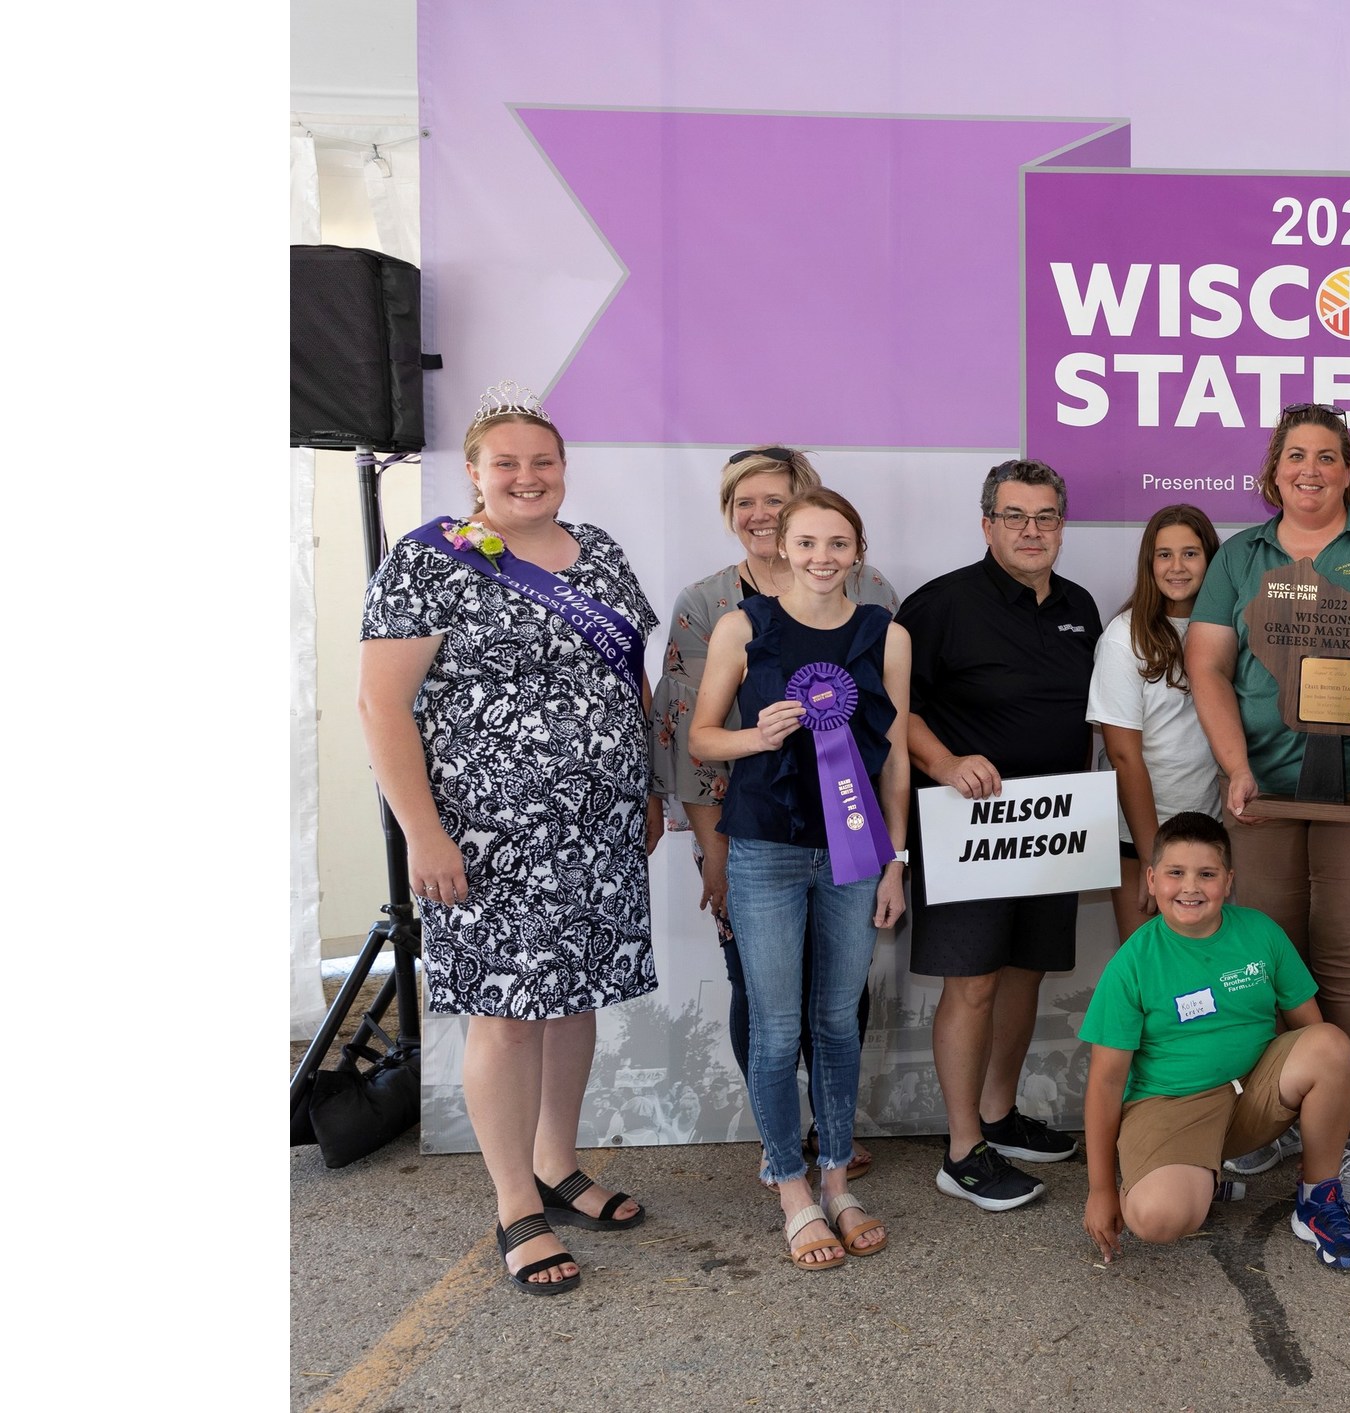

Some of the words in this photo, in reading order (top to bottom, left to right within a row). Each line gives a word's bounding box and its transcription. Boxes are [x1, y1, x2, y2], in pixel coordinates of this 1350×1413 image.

[1142, 474, 1235, 491] Presented
[1243, 475, 1263, 494] By
[1267, 582, 1318, 593] WISCONSIN
[1267, 591, 1296, 600] STATE
[1296, 592, 1317, 601] FAIR
[1320, 599, 1348, 611] 2022
[553, 585, 633, 653] Wisconsin
[1264, 622, 1311, 635] GRAND
[571, 614, 597, 634] of
[593, 631, 617, 660] the
[1267, 634, 1318, 647] CHEESE
[970, 793, 1073, 825] NELSON
[958, 830, 1088, 862] JAMESON
[1220, 974, 1238, 982] Crave
[1223, 976, 1251, 988] Brothers
